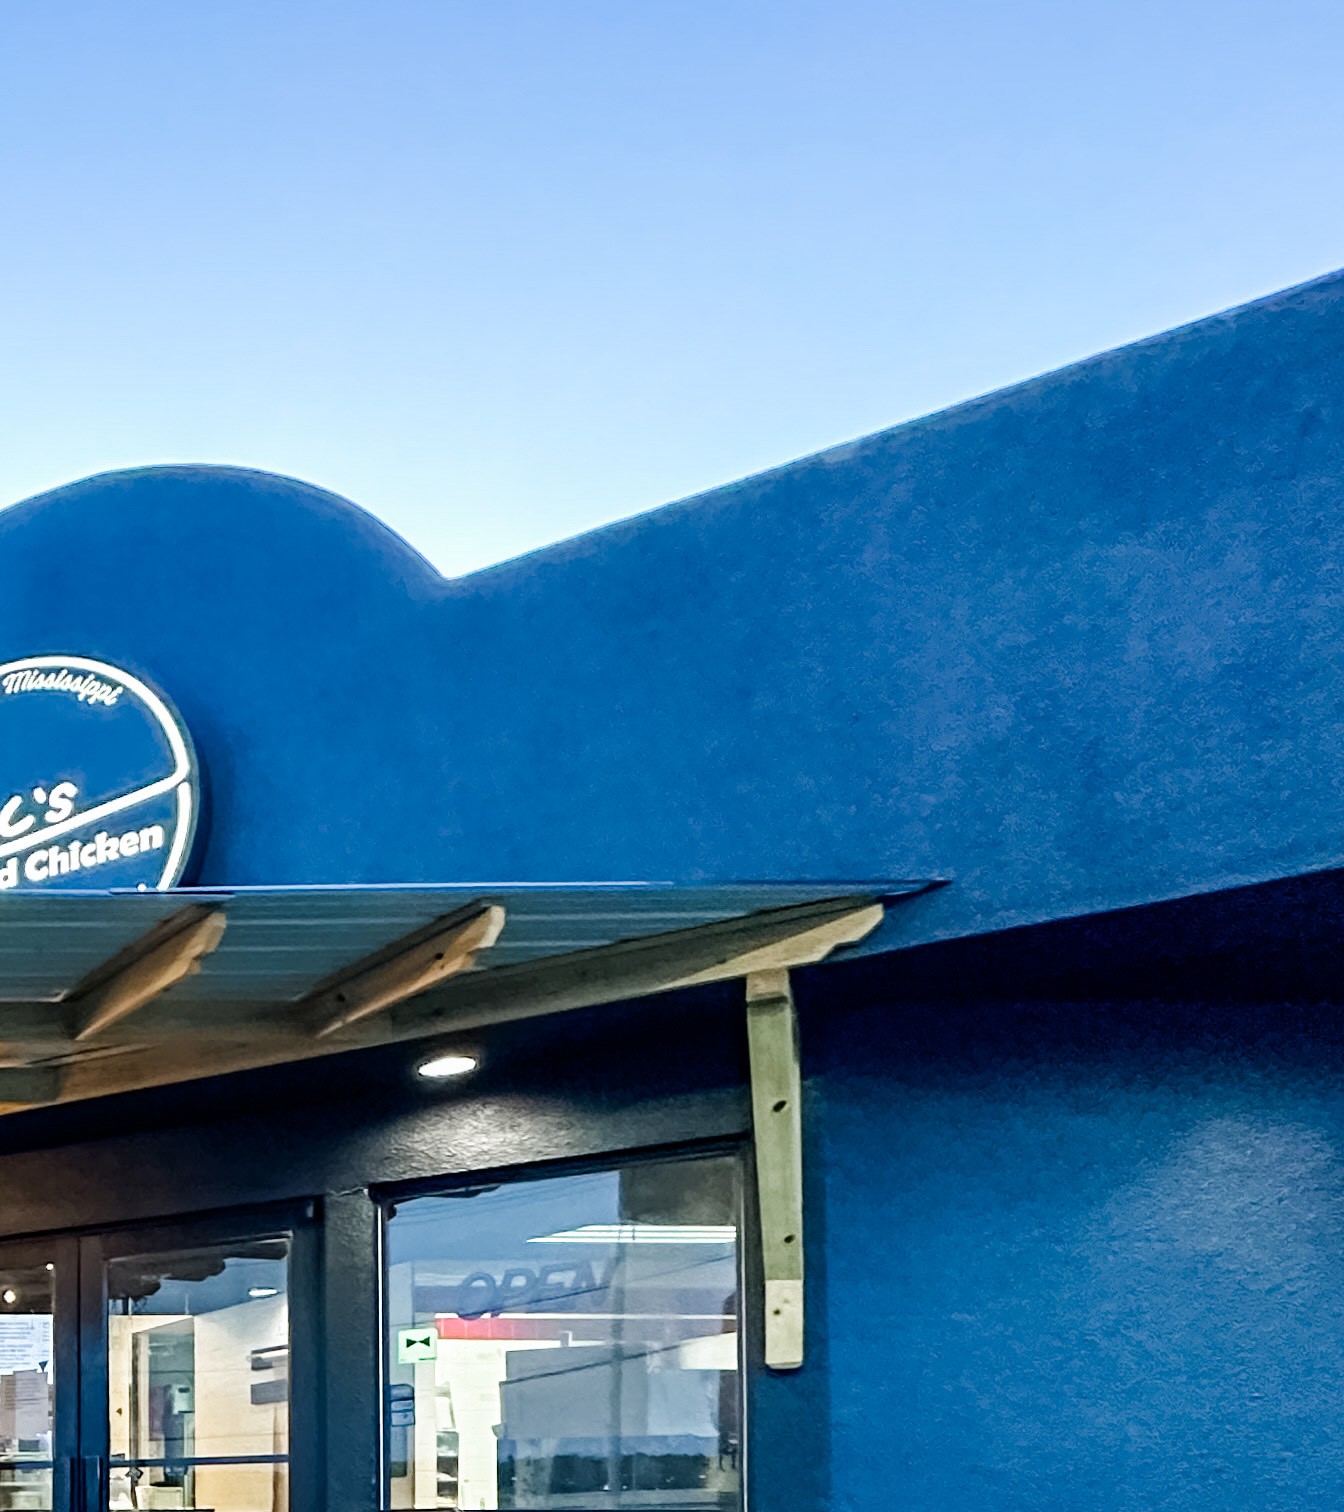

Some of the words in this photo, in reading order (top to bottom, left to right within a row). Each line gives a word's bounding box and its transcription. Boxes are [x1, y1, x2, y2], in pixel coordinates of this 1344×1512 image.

[2, 669, 124, 707] Mississippi
[25, 825, 164, 882] Chicken
[457, 1257, 616, 1320] OPEN
